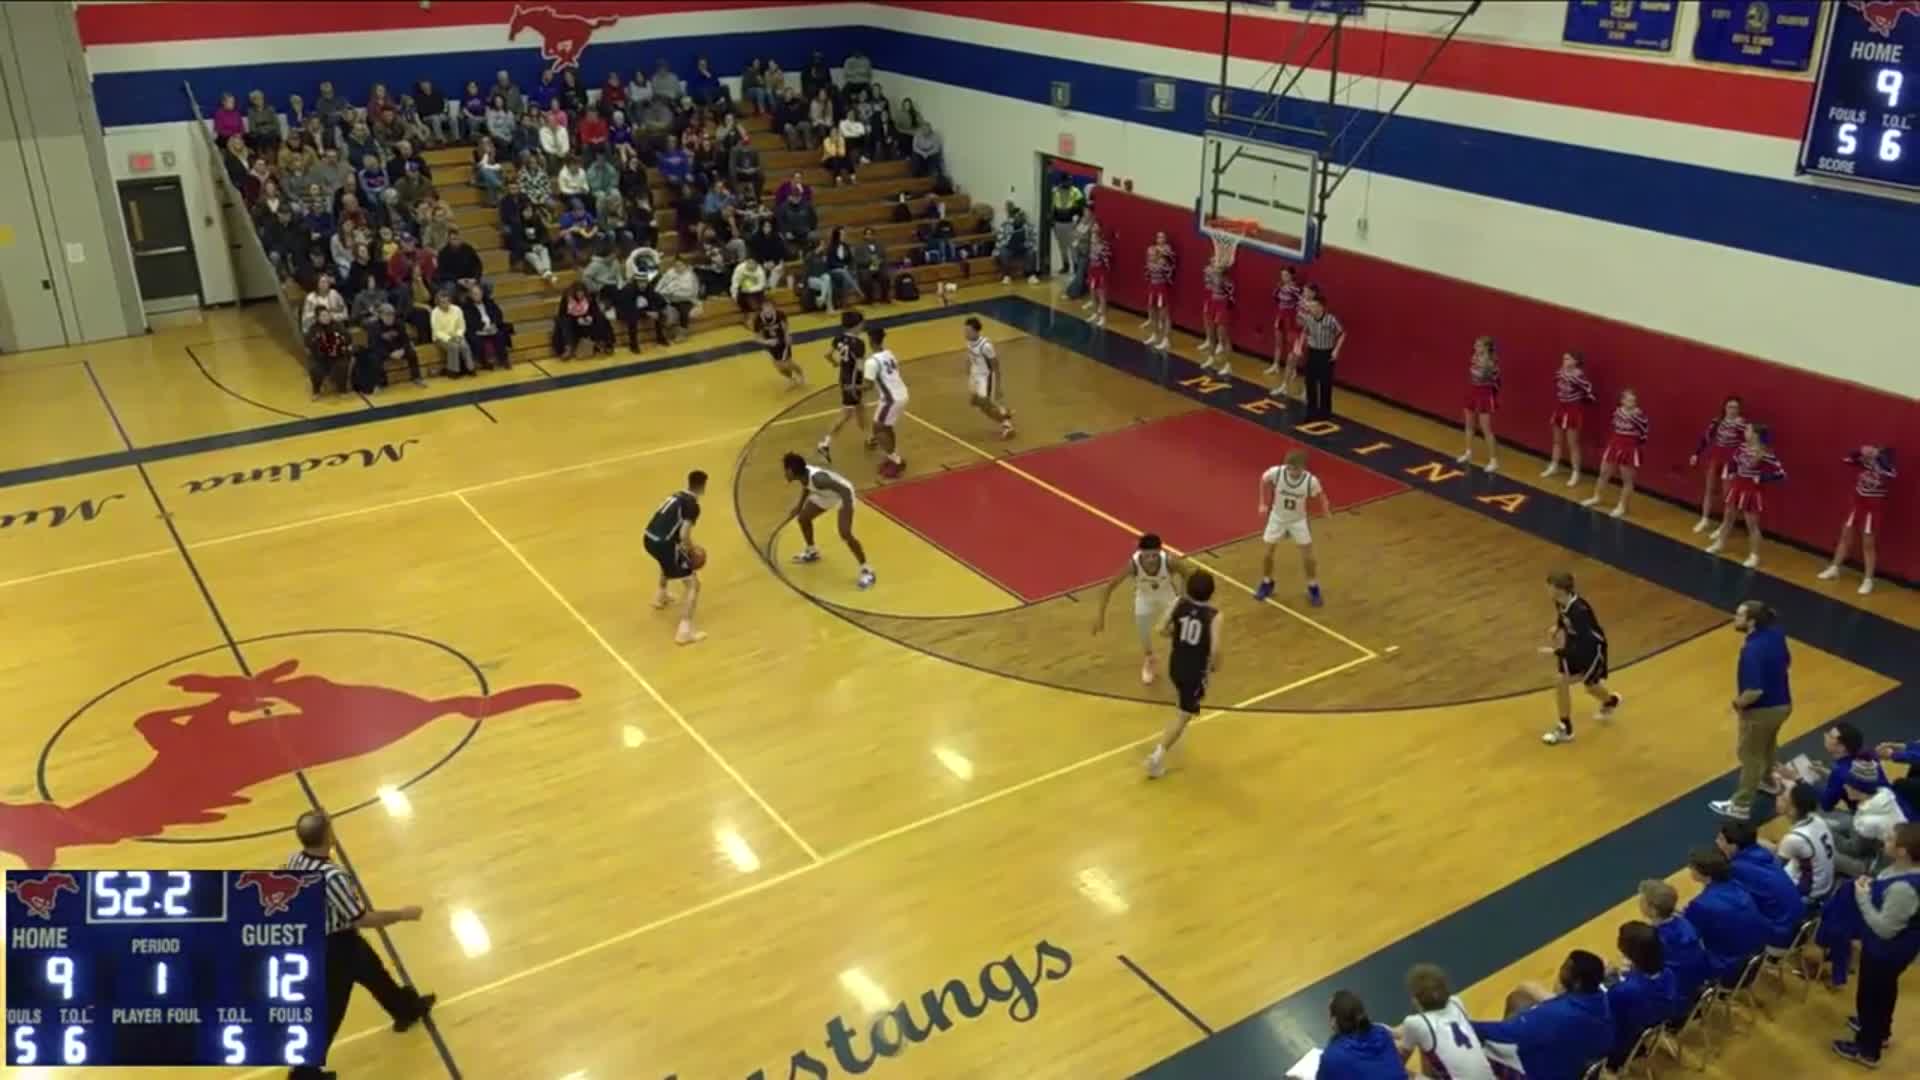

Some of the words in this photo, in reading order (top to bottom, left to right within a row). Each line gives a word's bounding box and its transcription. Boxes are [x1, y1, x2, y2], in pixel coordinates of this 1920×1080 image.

[1850, 41, 1904, 63] HOME
[1876, 68, 1904, 108] 9
[1828, 106, 1867, 124] FOULS
[1837, 122, 1858, 155] 5
[1879, 128, 1902, 162] 6
[183, 439, 421, 495] Medina
[1179, 615, 1202, 646] 10
[1820, 833, 1833, 860] 5
[1450, 1021, 1473, 1050] 4
